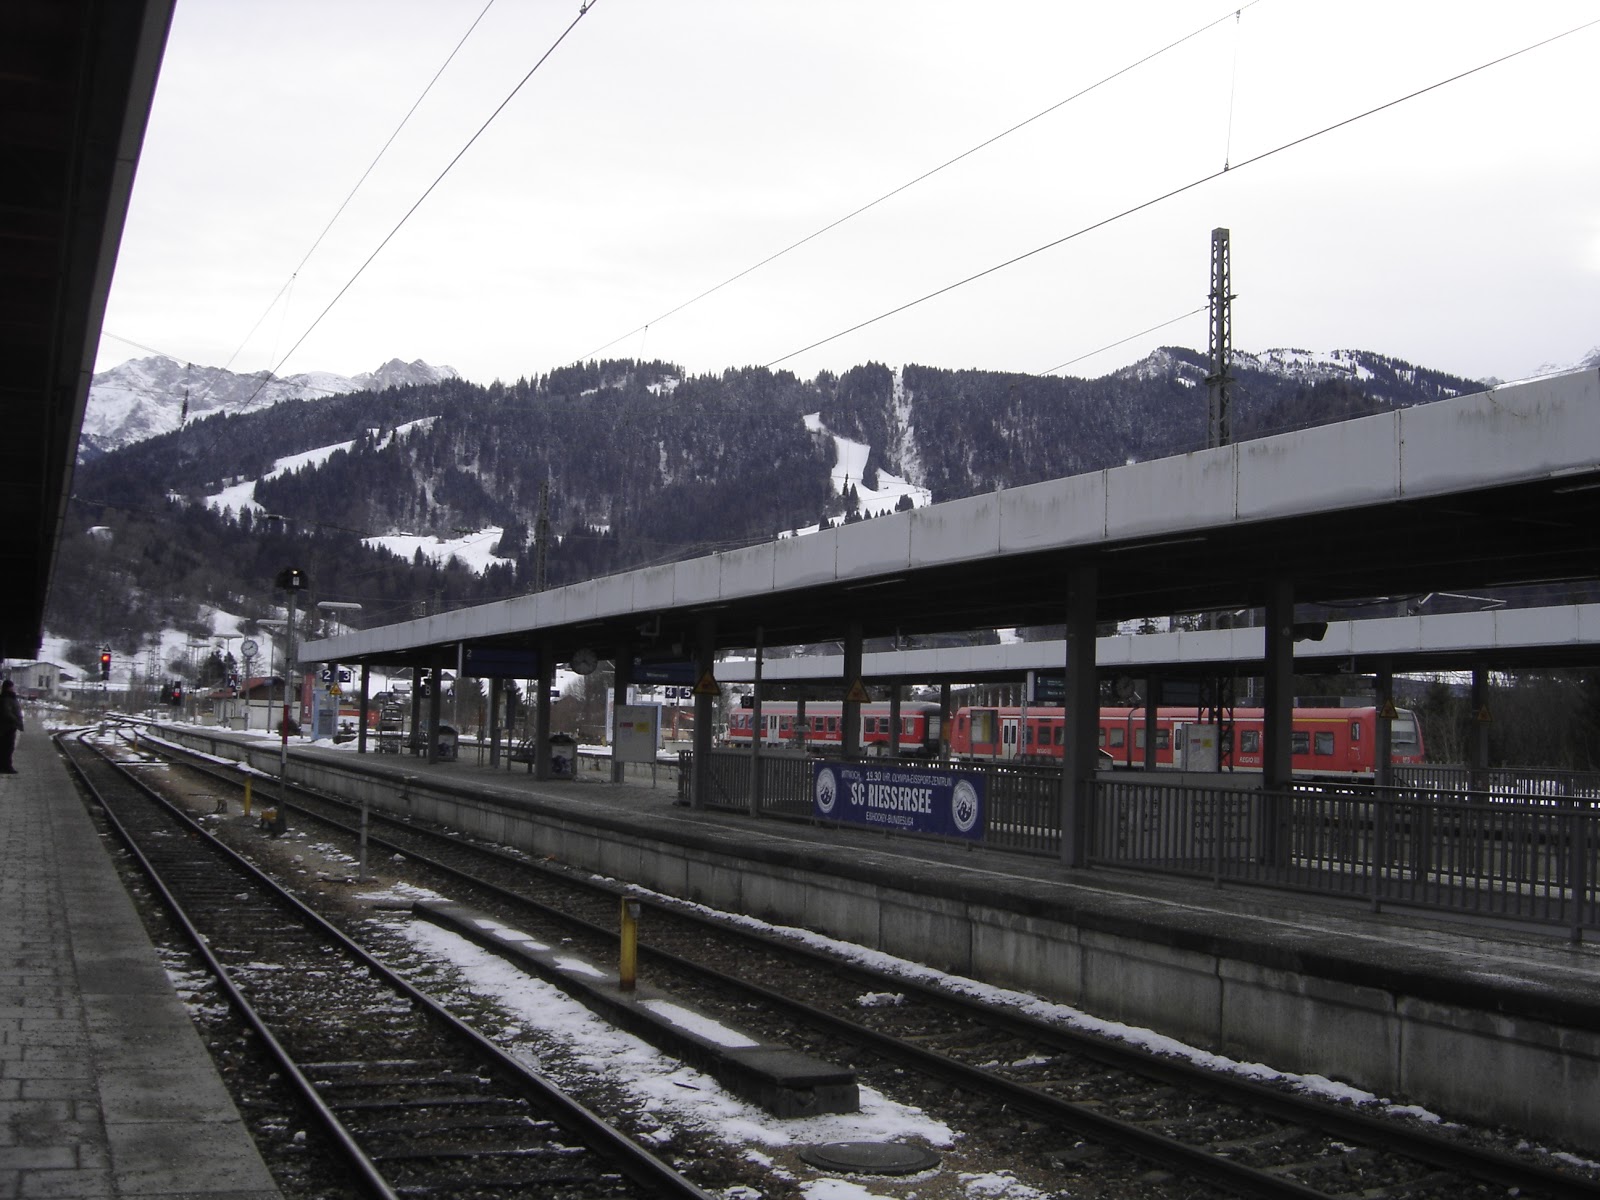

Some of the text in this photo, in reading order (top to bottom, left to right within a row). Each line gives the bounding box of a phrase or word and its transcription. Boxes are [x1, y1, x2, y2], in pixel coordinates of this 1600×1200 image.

[466, 649, 472, 658] 2
[323, 669, 331, 680] 2
[343, 671, 350, 681] 3
[229, 679, 236, 687] A
[425, 684, 431, 696] B
[447, 688, 453, 696] A
[666, 687, 673, 697] 4
[684, 689, 691, 698] 5
[851, 782, 865, 806] SC
[868, 783, 933, 814] RIESSERSEE
